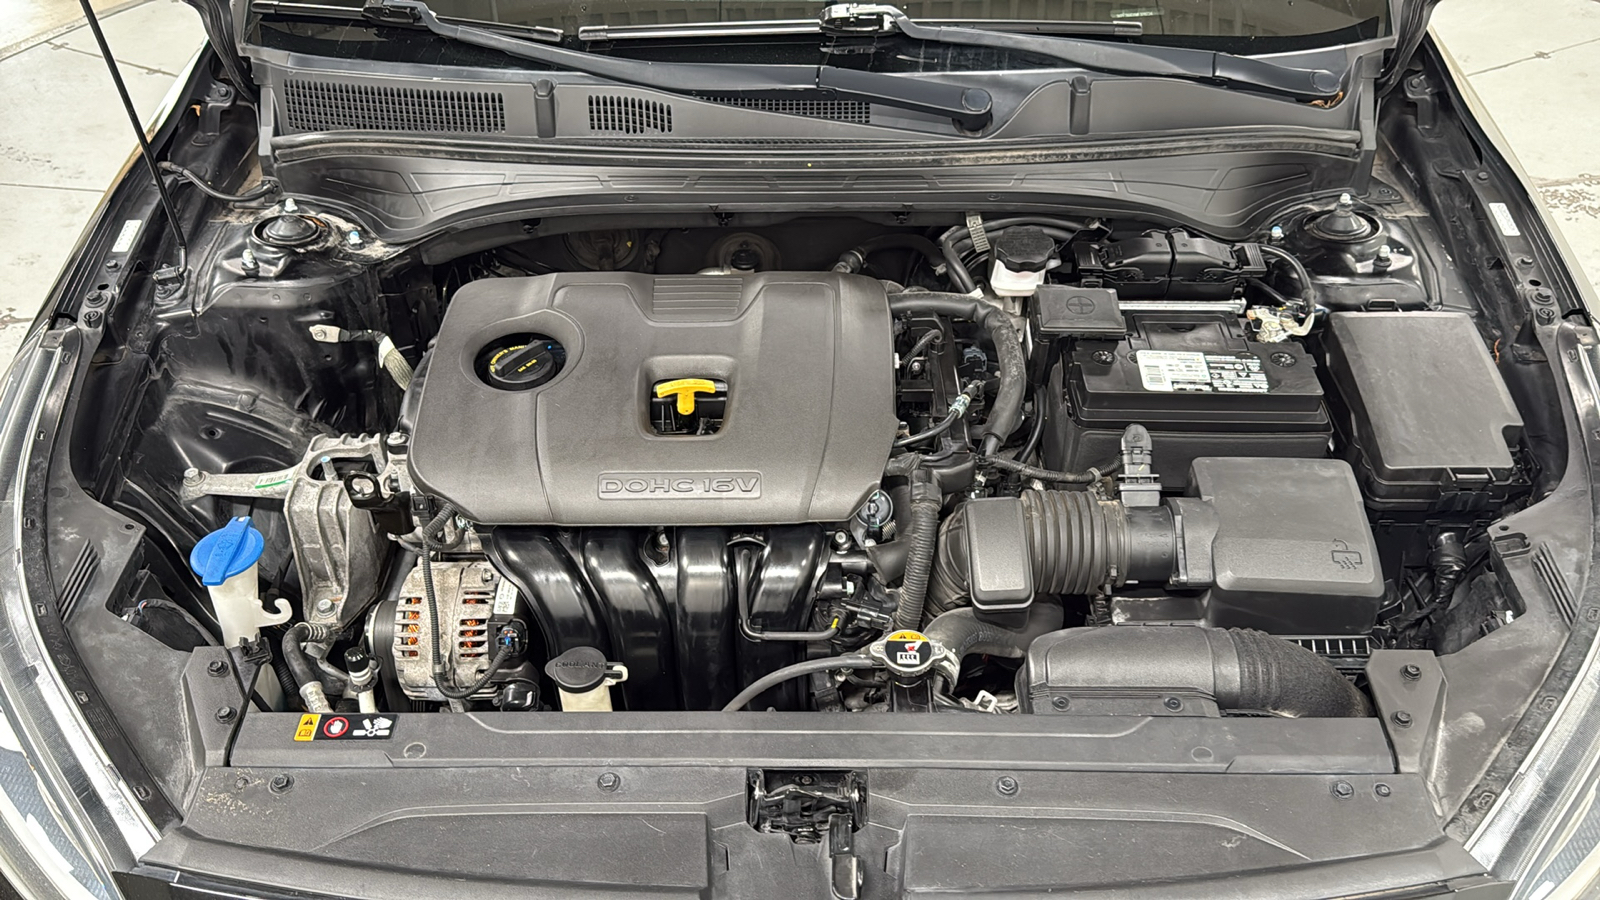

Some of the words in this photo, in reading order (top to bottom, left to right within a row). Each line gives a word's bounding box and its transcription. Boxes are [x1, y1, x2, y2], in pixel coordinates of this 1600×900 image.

[600, 478, 694, 494] DOHC
[703, 477, 759, 492] 16V
[555, 660, 607, 670] COOLANT
